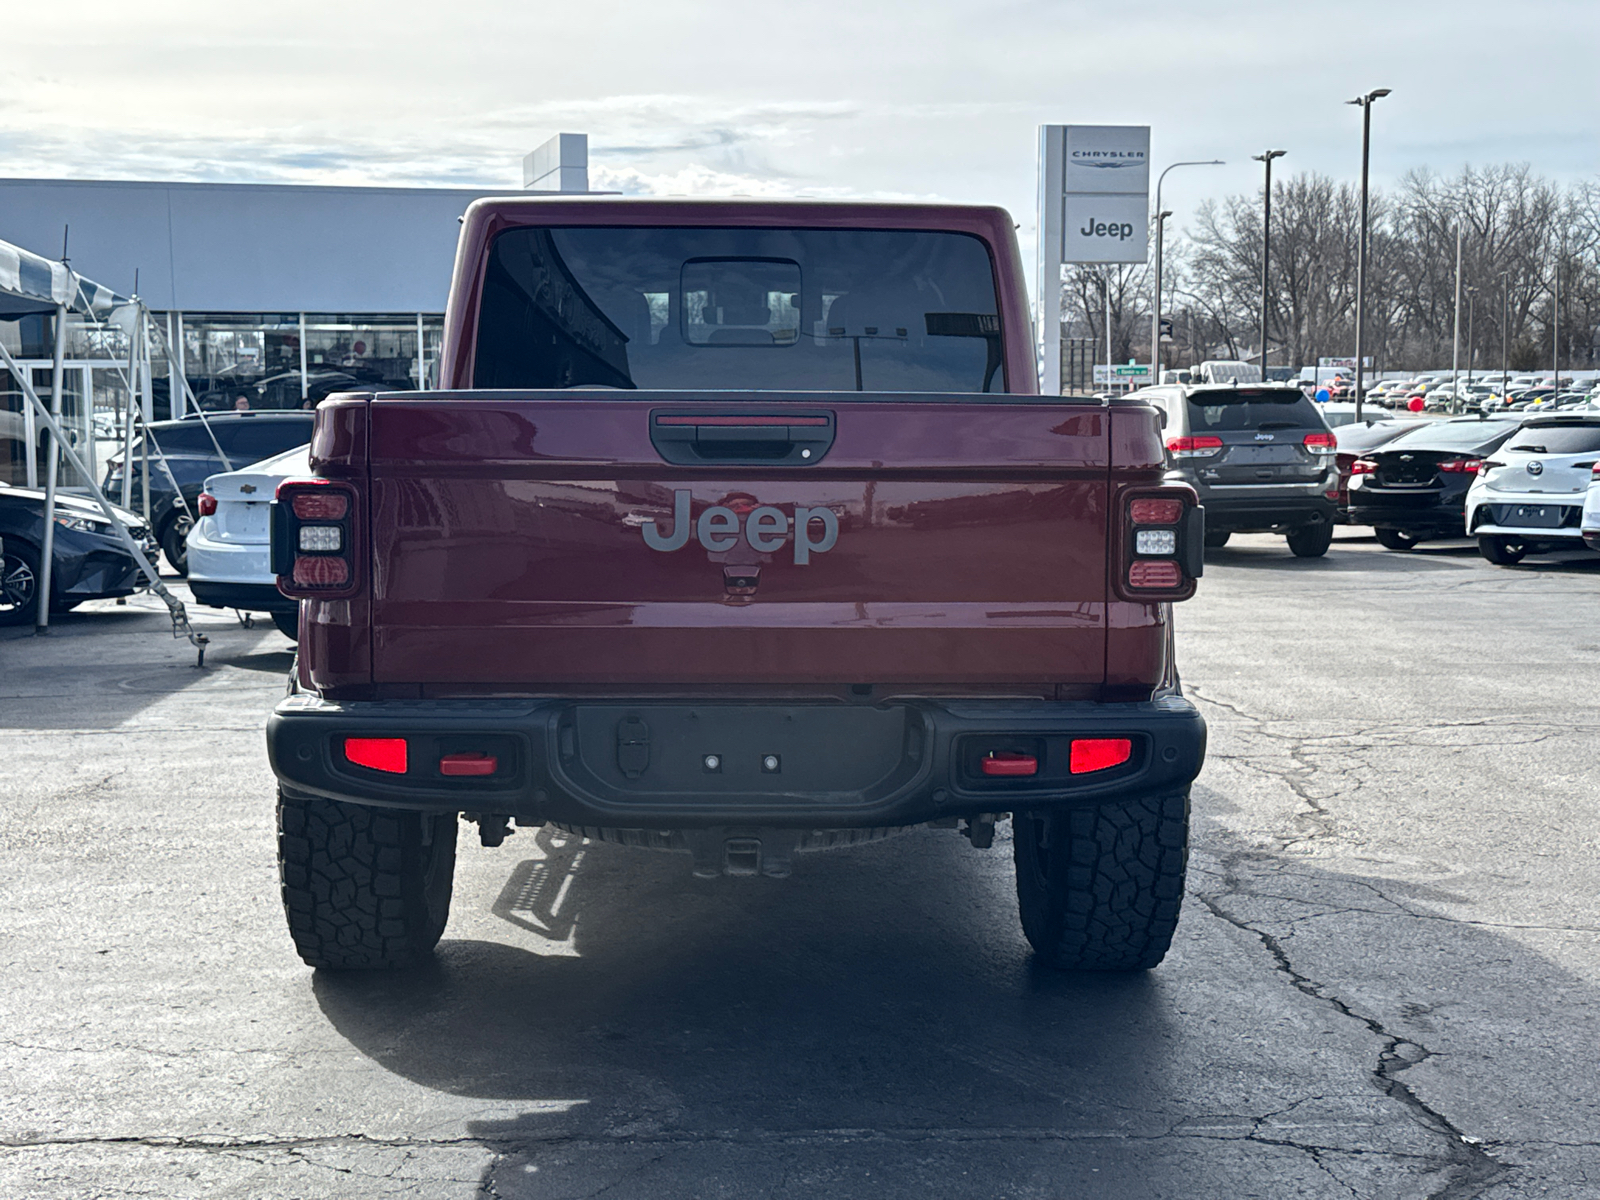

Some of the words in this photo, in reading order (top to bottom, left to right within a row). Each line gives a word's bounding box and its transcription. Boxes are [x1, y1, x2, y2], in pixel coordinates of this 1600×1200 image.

[1072, 150, 1144, 158] CHRYSLER
[1080, 217, 1133, 241] Jeep
[1254, 433, 1275, 441] Jeep
[641, 488, 839, 566] Jeep
